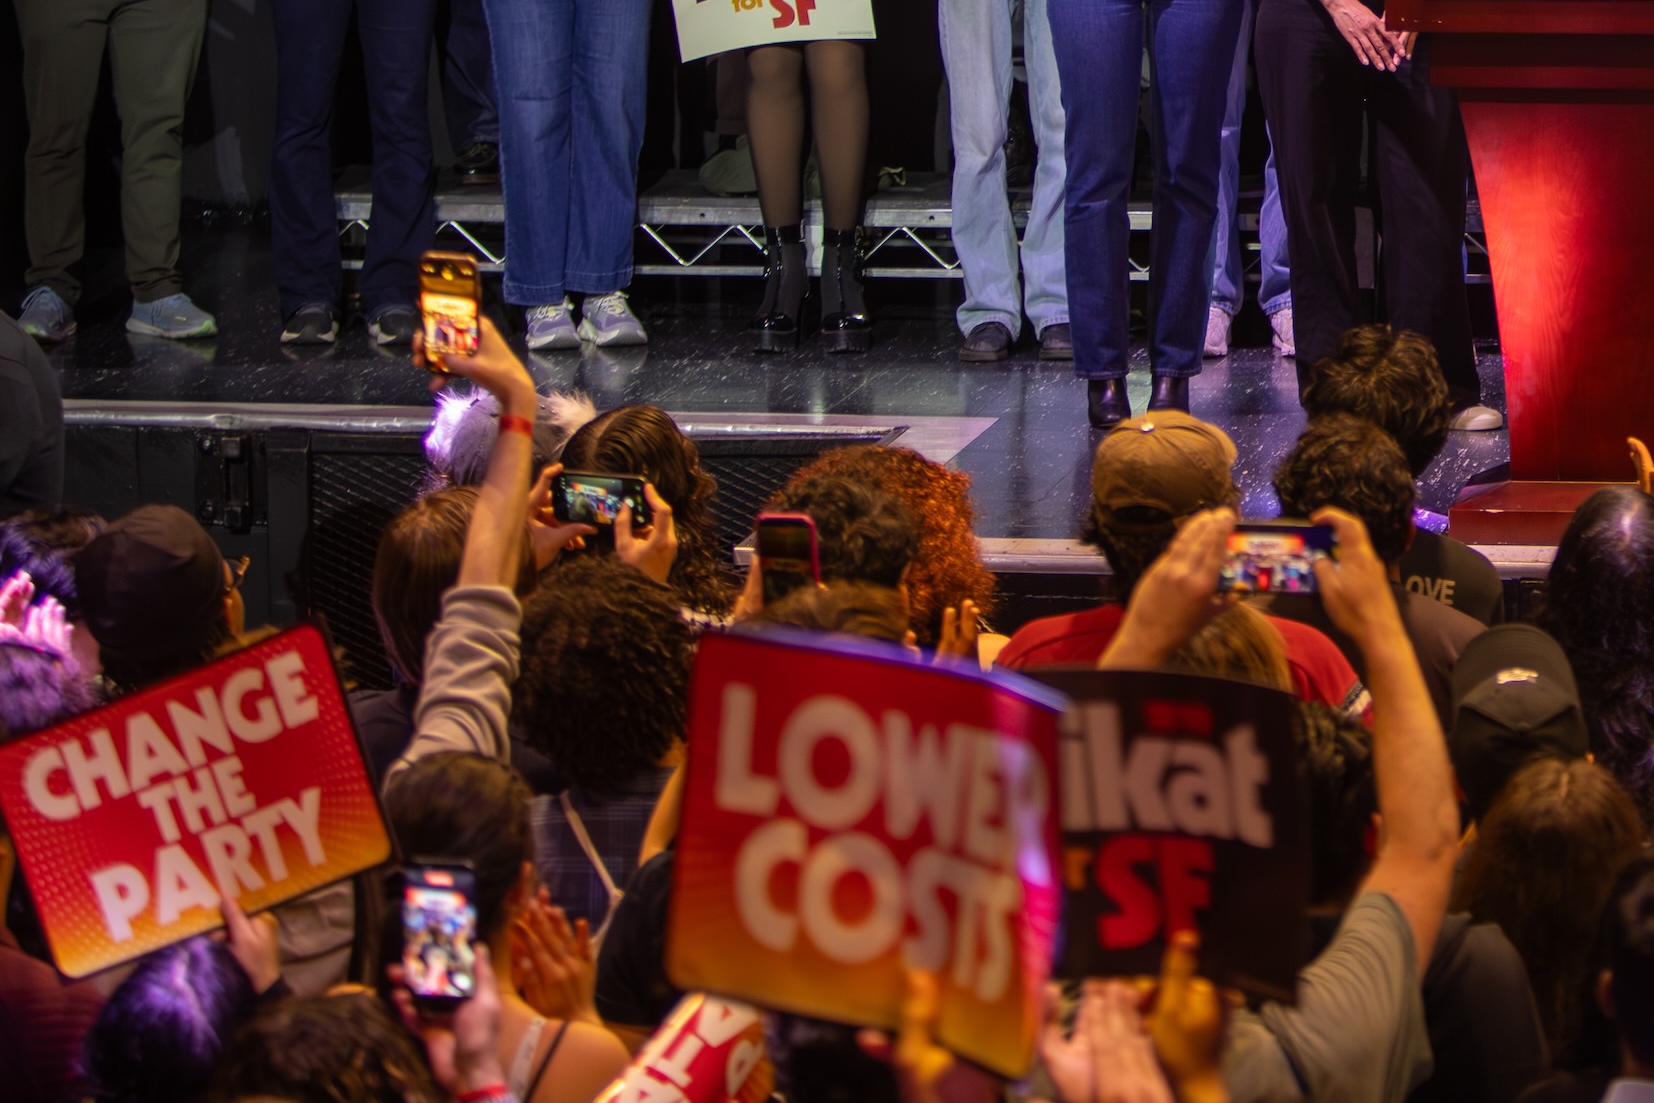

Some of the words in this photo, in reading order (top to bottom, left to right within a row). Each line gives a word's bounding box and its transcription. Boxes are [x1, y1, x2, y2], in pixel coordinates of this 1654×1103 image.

[1405, 574, 1456, 605] OVE
[22, 650, 320, 821] CHANGE
[138, 755, 256, 843] THE
[715, 683, 1051, 888] LOWER
[1062, 701, 1275, 849] ikat
[89, 787, 327, 943] PARTY
[735, 817, 1021, 1002] COSTS
[1096, 834, 1215, 950] SF
